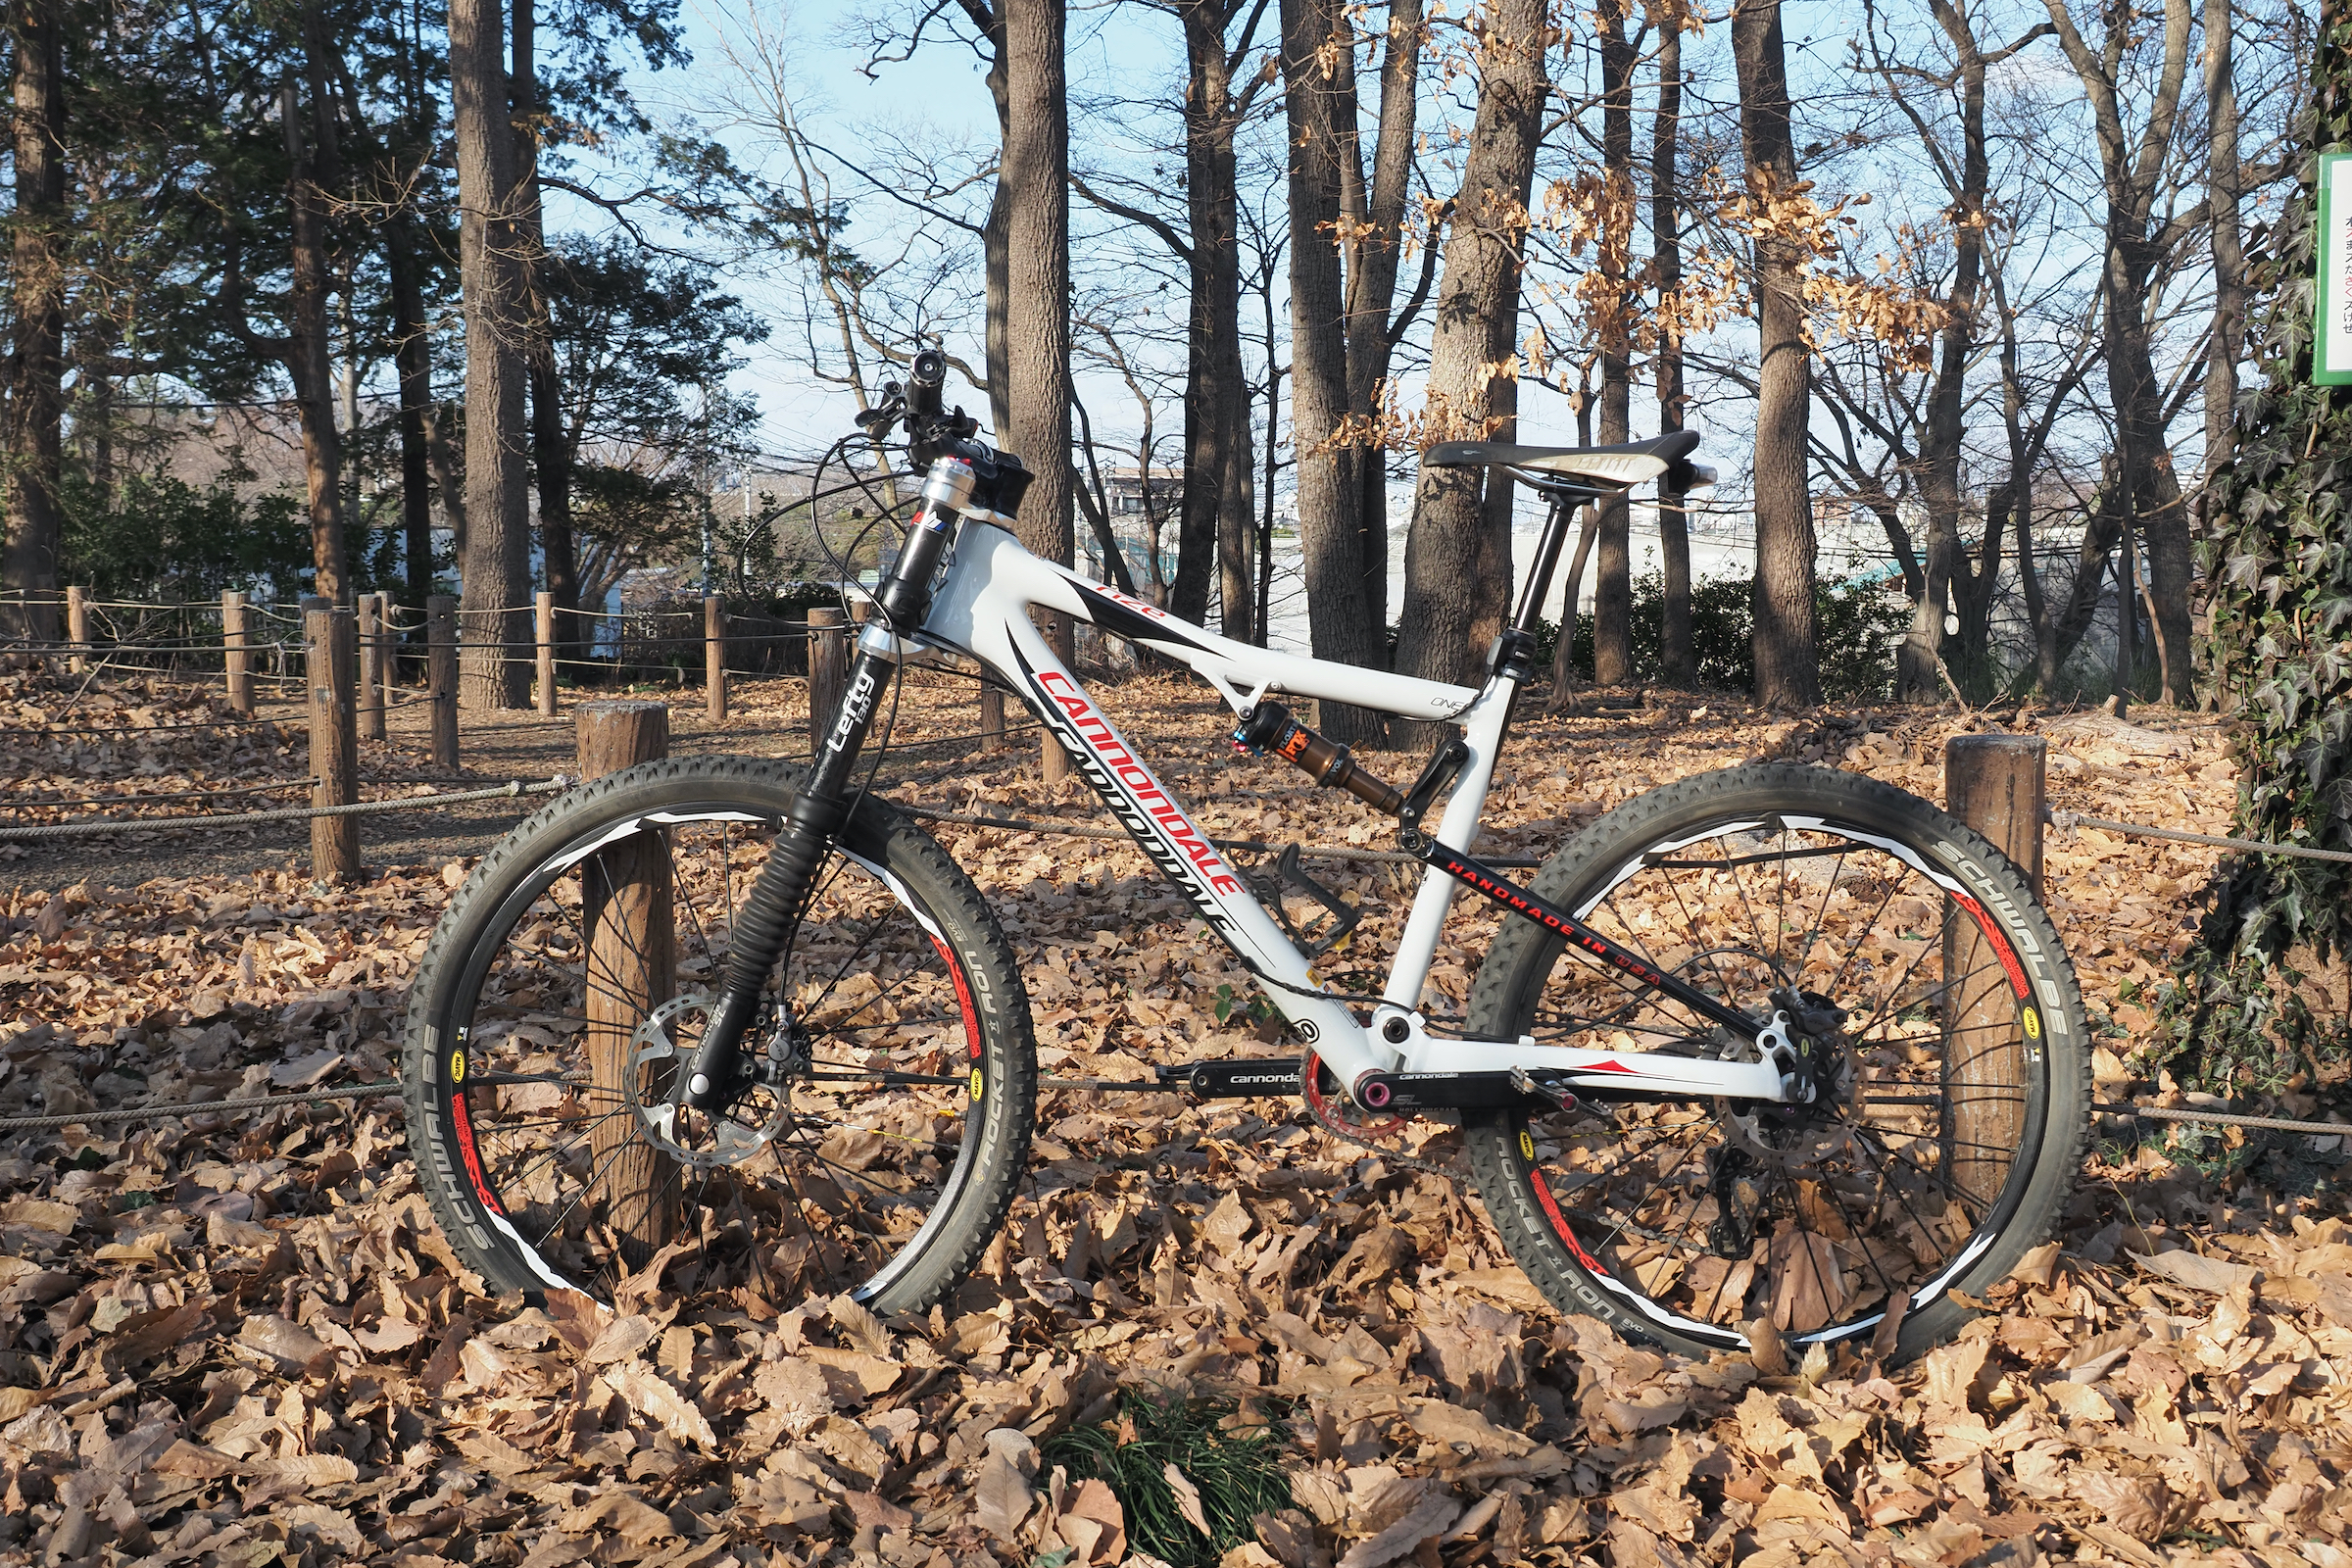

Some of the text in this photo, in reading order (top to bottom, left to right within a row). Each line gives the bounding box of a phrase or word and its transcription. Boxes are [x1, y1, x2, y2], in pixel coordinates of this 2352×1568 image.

[826, 670, 875, 753] Lefty
[855, 695, 872, 724] 130
[1285, 729, 1310, 756] FOX
[1447, 860, 1661, 986] HANDMADE IN USA
[1932, 840, 2068, 1035] SCHWALBE
[713, 1008, 727, 1027] SL
[2028, 1011, 2037, 1034] MAVIC
[690, 1004, 721, 1070] cannondale
[454, 1054, 464, 1078] MAVIC
[1230, 1072, 1300, 1084] cannonda
[981, 1046, 1004, 1168] ROCKET
[422, 1023, 495, 1250] SCHWALBE
[1522, 1134, 1532, 1155] MAVIC
[1495, 1136, 1553, 1250] ROCKET
[1622, 1317, 1644, 1333] EVO
